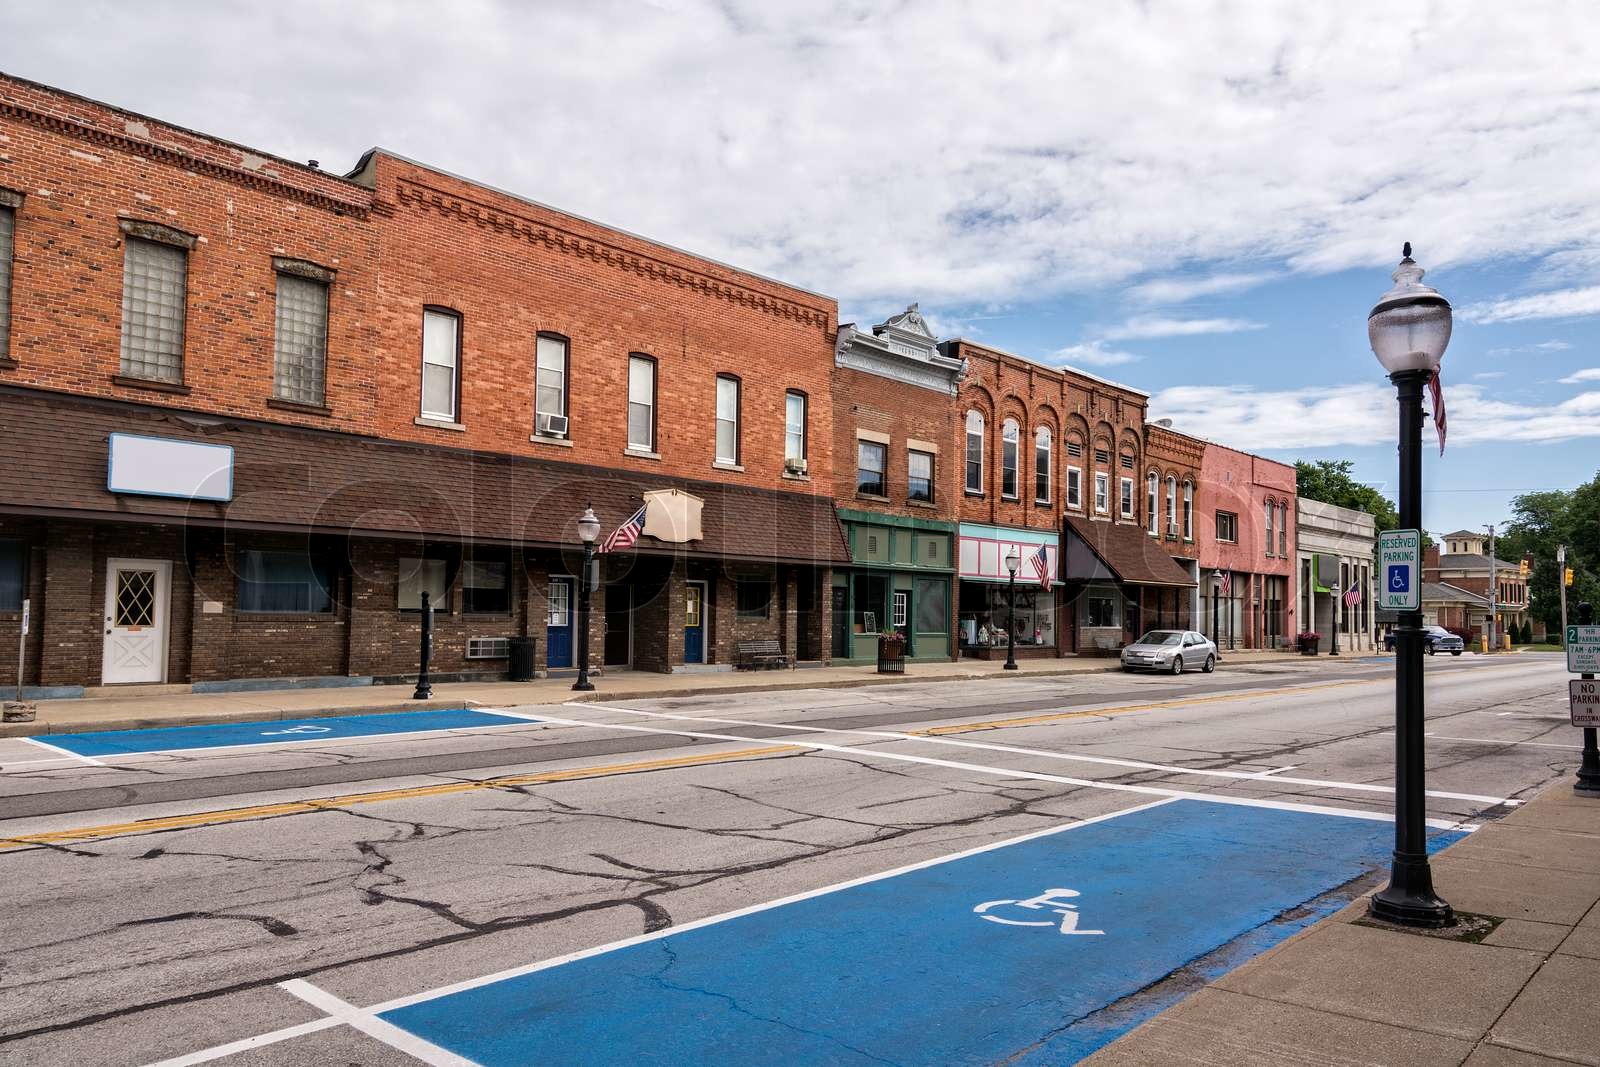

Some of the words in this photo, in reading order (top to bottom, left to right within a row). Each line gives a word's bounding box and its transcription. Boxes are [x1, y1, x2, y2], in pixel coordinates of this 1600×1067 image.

[1382, 537, 1416, 548] RESERVED
[1384, 552, 1414, 562] PARKING
[1389, 595, 1408, 605] ONLY
[1569, 629, 1576, 641] 2
[1581, 684, 1595, 693] NO
[1573, 695, 1600, 704] PARKIN
